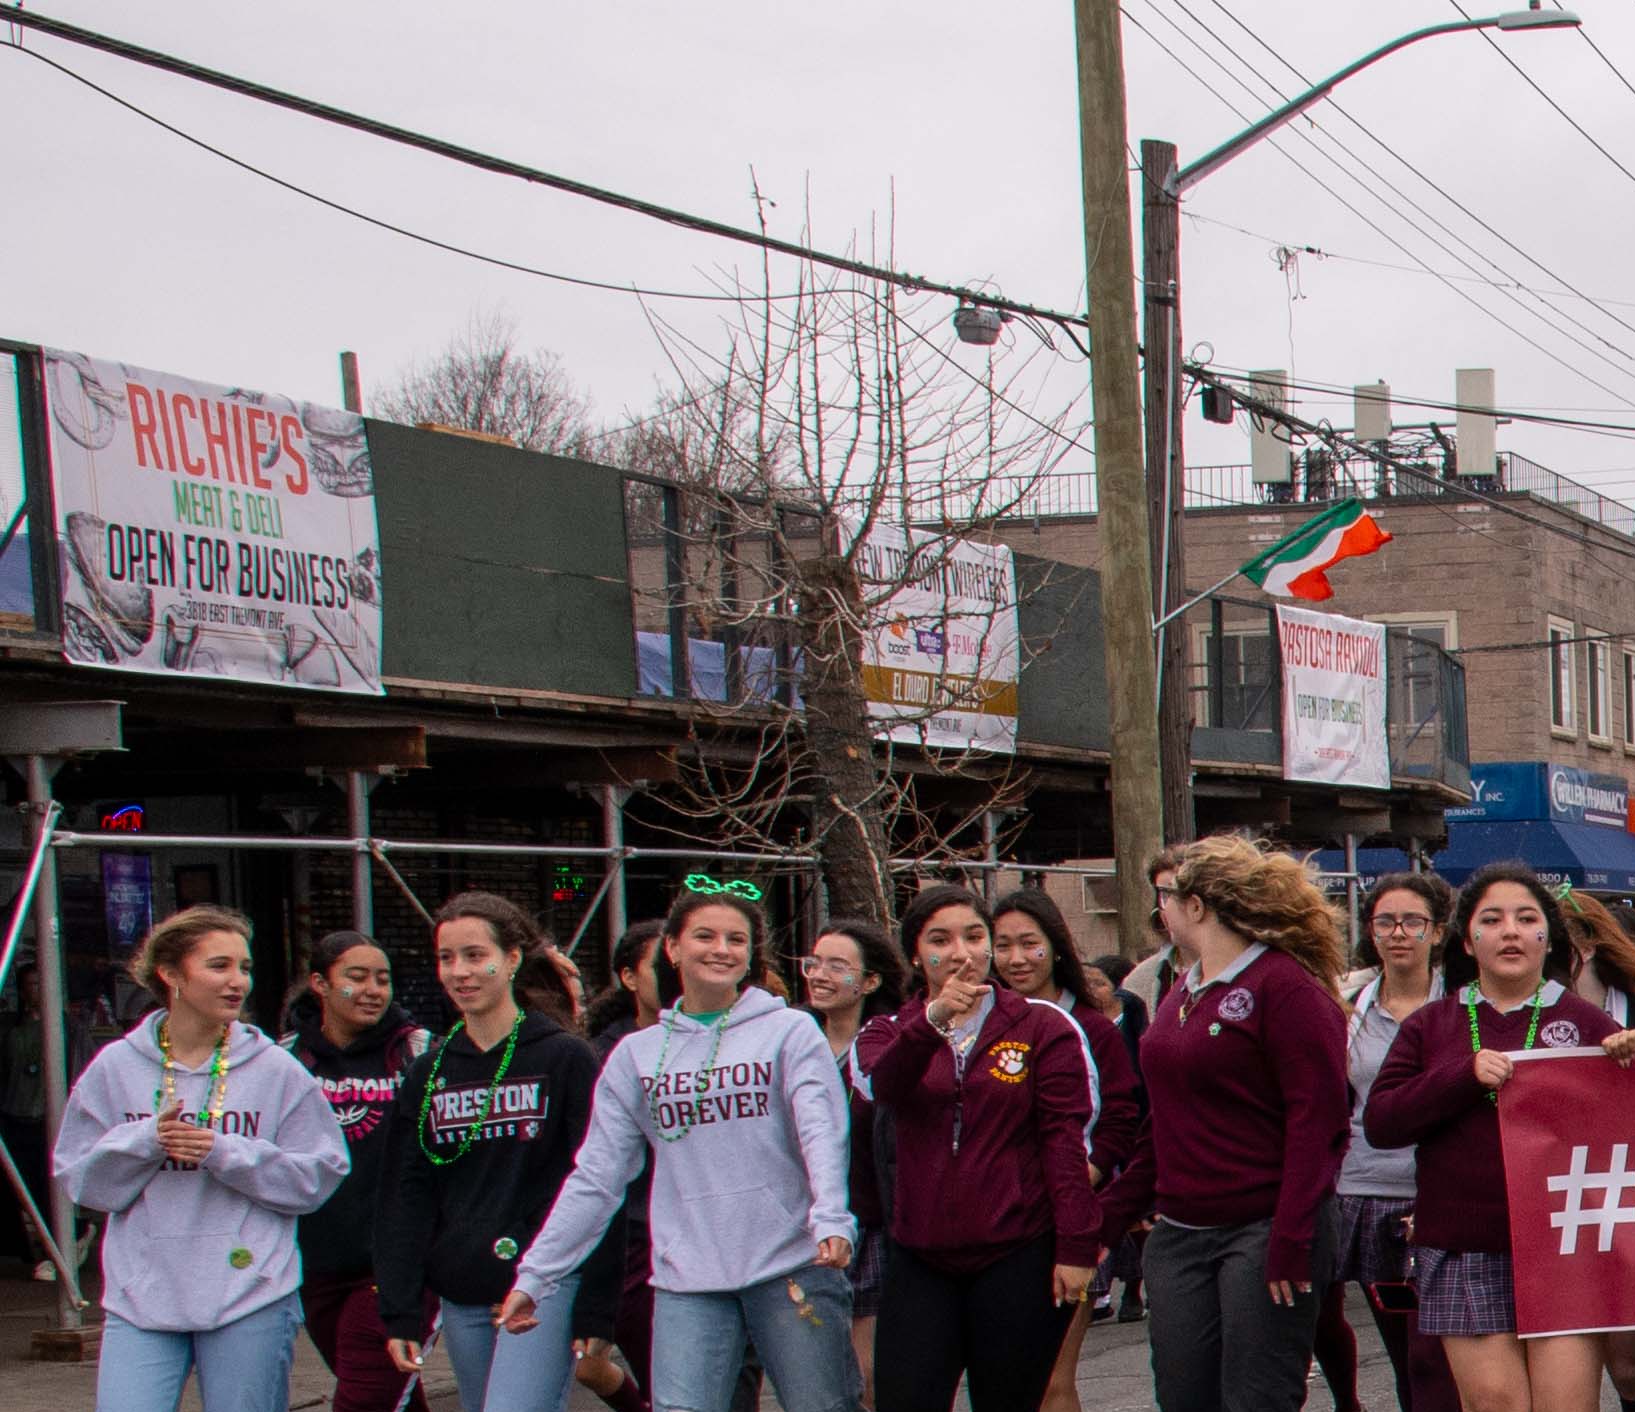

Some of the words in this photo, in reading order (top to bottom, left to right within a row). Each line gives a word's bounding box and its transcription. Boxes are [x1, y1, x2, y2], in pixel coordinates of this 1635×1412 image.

[126, 383, 308, 495] RICHIE'S
[172, 480, 223, 528] MEAT
[228, 490, 242, 532] &
[245, 496, 284, 539] DELI
[107, 524, 175, 588] OPEN
[183, 534, 230, 594] FOR
[237, 542, 350, 610] BUSINESS
[209, 603, 229, 624] EAST
[1281, 620, 1332, 671] PASTOSA
[1336, 631, 1380, 679] RAVIOLI
[1298, 693, 1317, 719] OPEN
[433, 1083, 540, 1122] PRESTON
[640, 1061, 773, 1100] PRESTON
